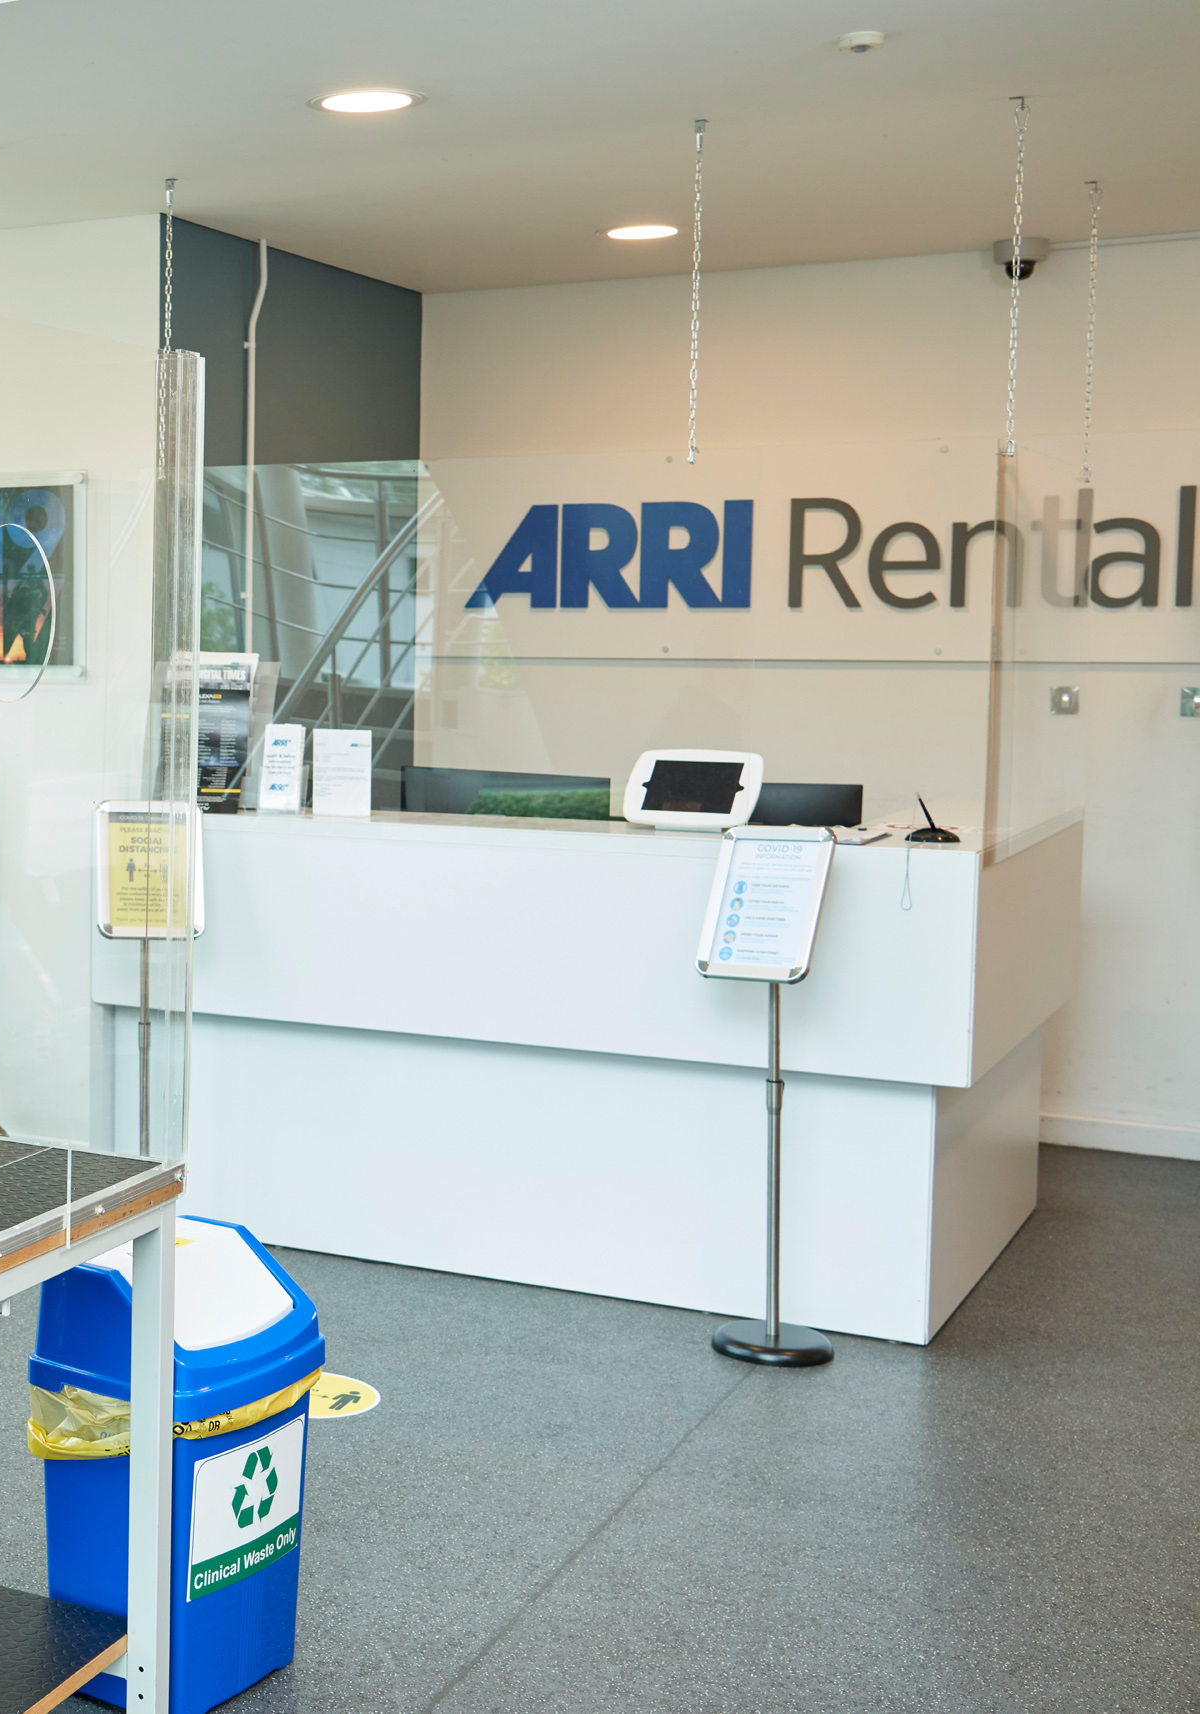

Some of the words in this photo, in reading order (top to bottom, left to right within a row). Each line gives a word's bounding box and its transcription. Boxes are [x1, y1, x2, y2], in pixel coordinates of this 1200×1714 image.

[464, 499, 754, 609] ARRI
[788, 485, 1197, 609] Rental
[222, 669, 246, 681] TIMES
[757, 844, 803, 853] COVID-19
[193, 1557, 240, 1590] Clinical
[243, 1543, 275, 1569] Waste
[276, 1527, 297, 1550] Only
